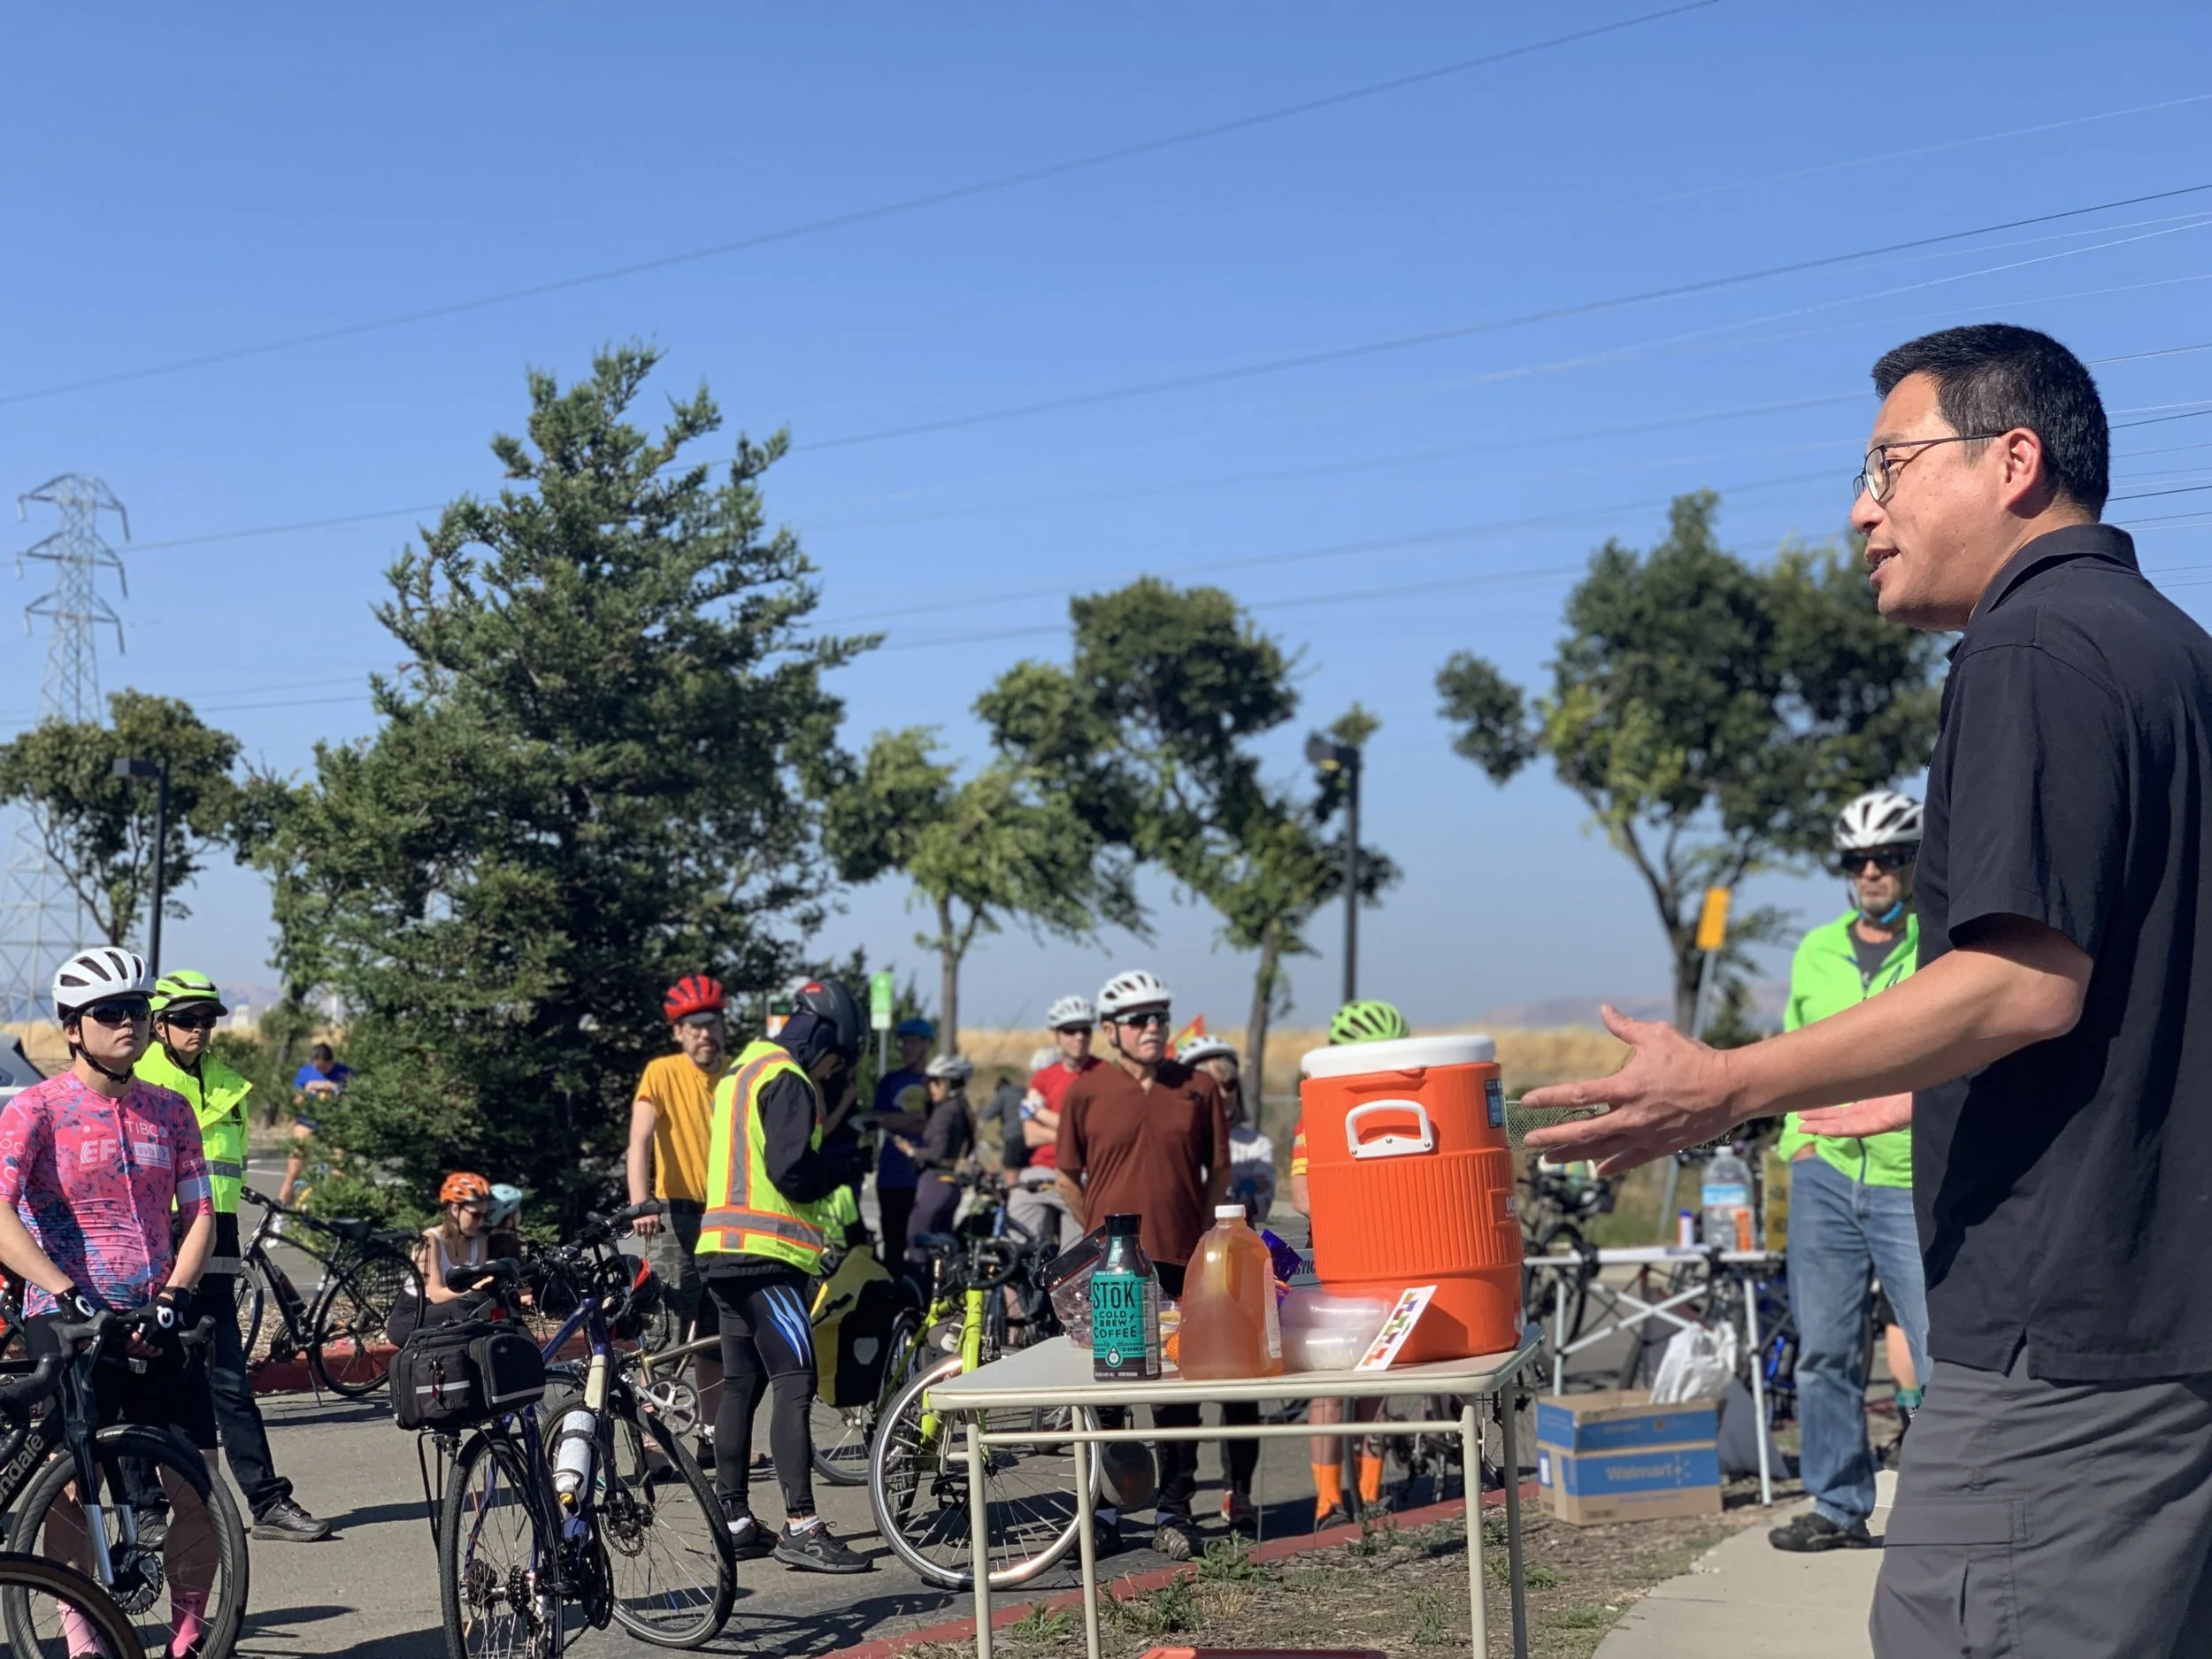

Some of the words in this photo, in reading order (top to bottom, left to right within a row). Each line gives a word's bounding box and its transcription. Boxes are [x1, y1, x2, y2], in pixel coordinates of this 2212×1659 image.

[81, 1139, 117, 1164] EF
[1094, 1325, 1137, 1338] COFFEE
[1606, 1463, 1673, 1482] Walmart
